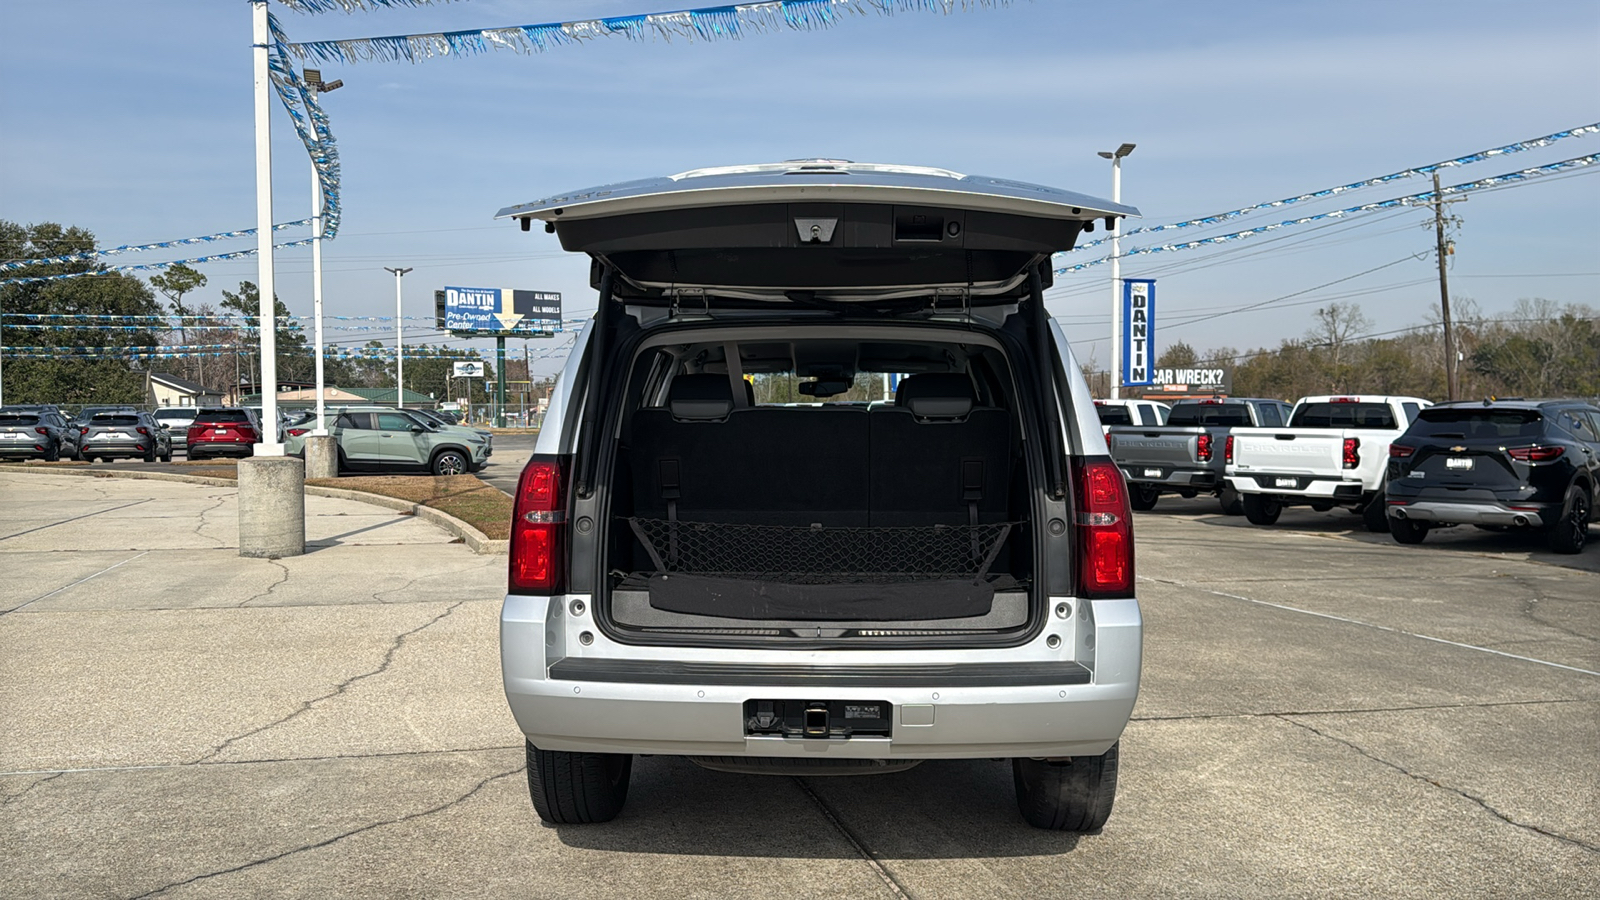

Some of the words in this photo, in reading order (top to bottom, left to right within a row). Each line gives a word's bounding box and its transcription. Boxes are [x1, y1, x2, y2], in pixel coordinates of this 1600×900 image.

[447, 290, 494, 306] DANTIN
[447, 312, 491, 321] Pre-Owned
[1133, 295, 1146, 381] DANTIN
[1175, 369, 1224, 385] WRECK?
